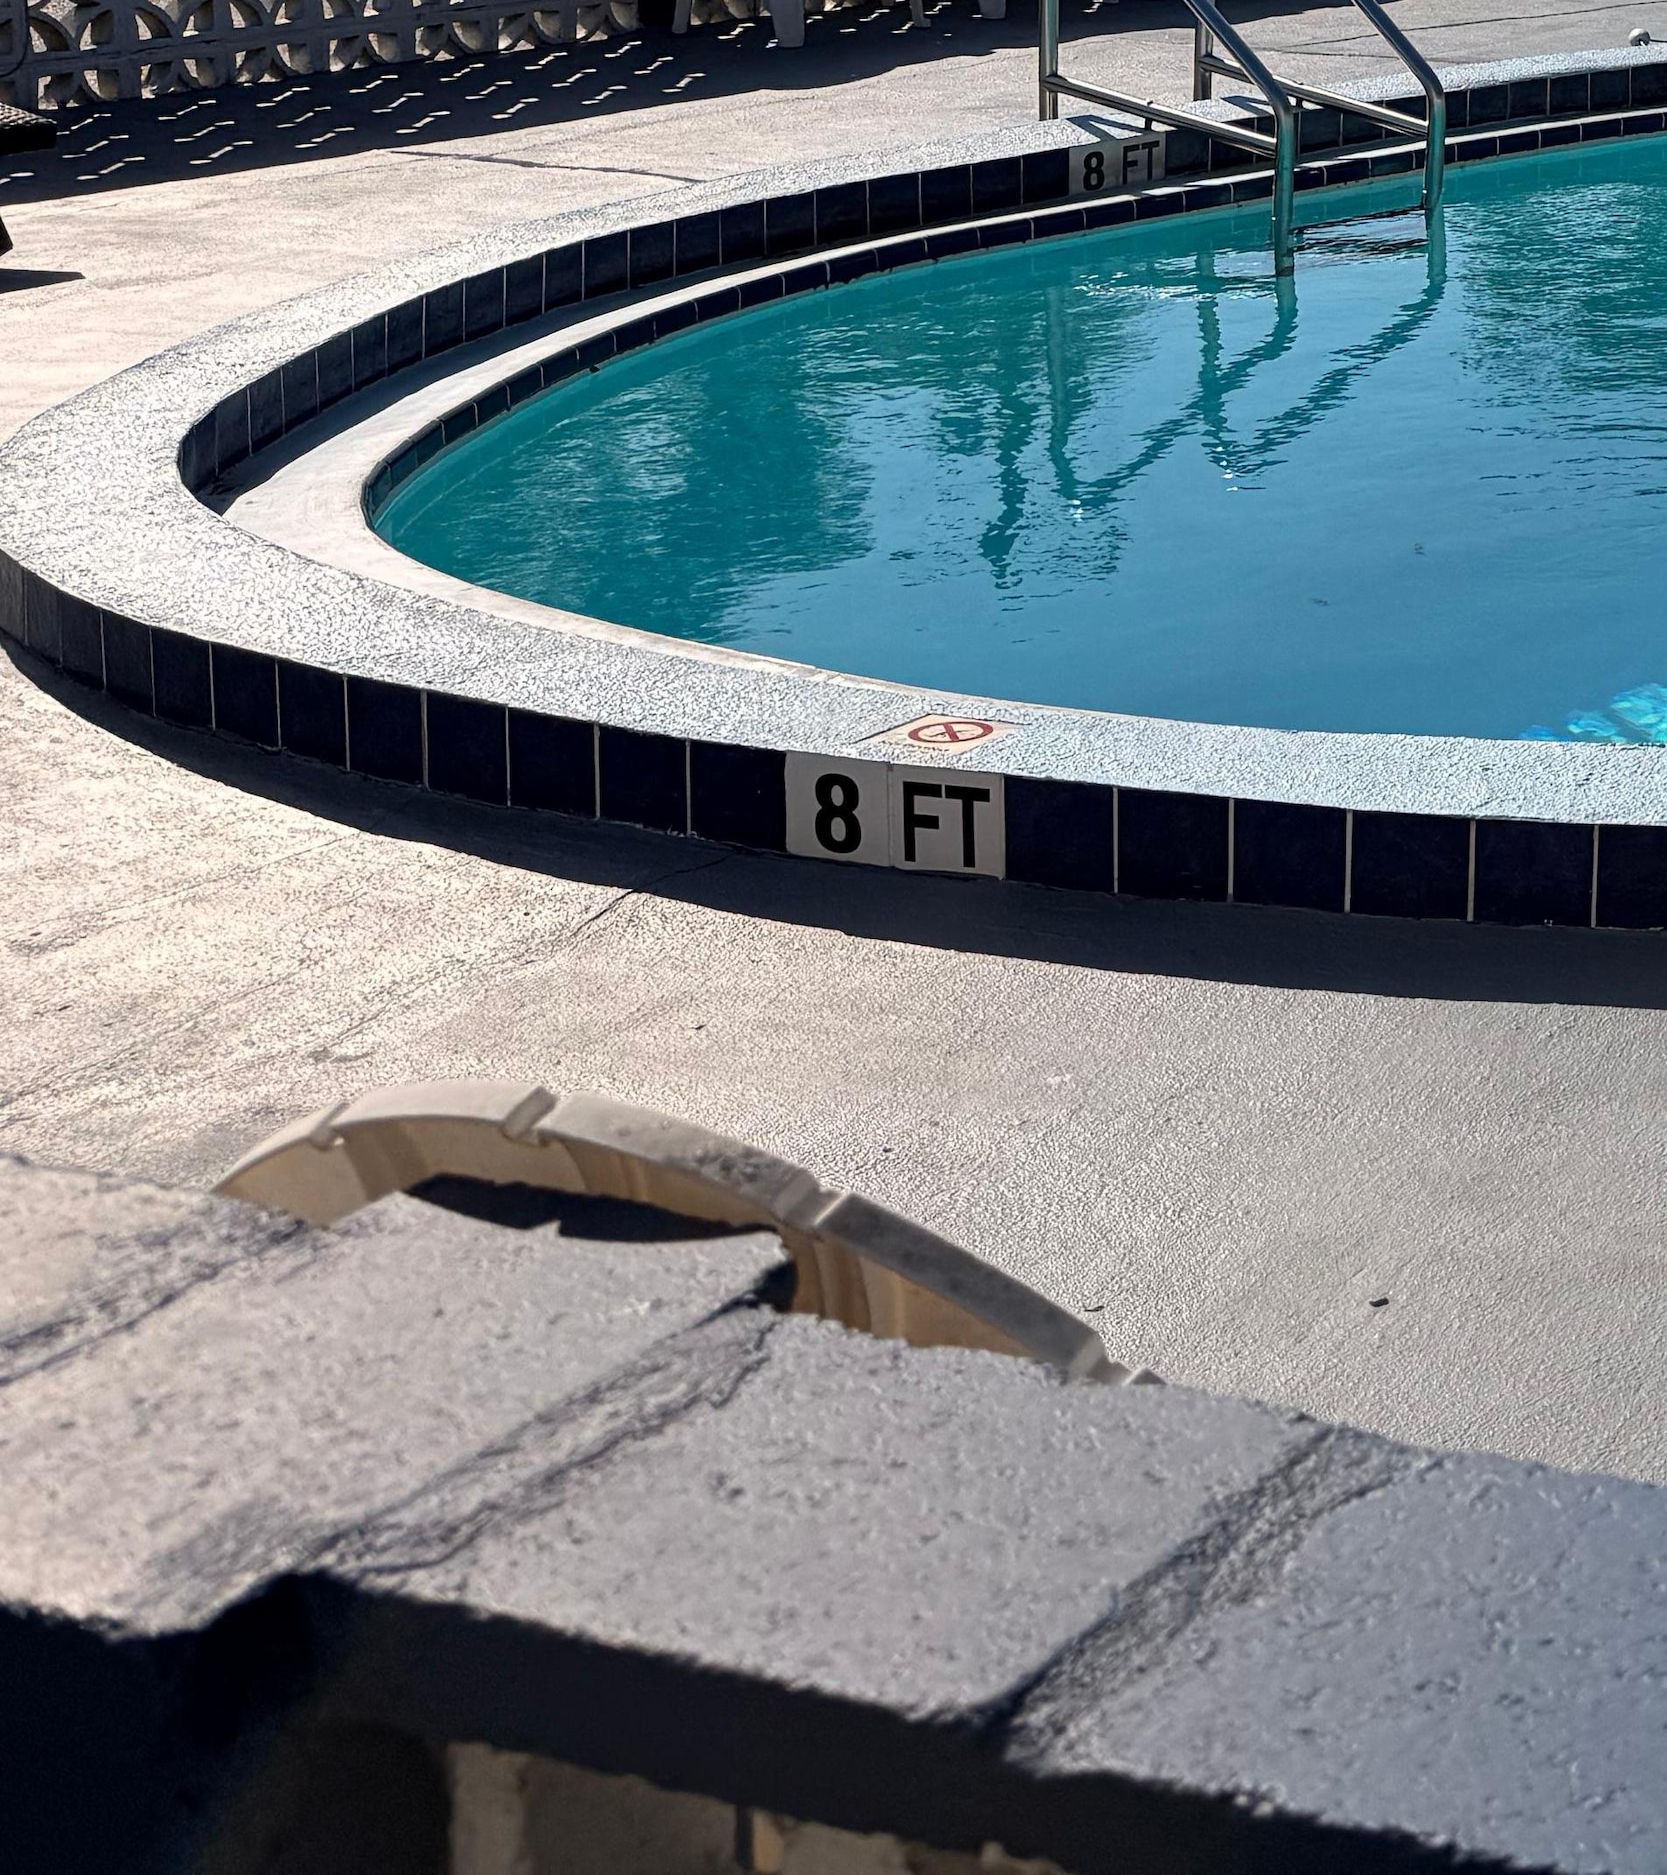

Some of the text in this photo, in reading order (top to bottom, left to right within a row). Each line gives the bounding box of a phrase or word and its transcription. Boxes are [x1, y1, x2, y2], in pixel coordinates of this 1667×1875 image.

[1082, 140, 1160, 191] 8 FT
[815, 773, 991, 868] 8 FT
